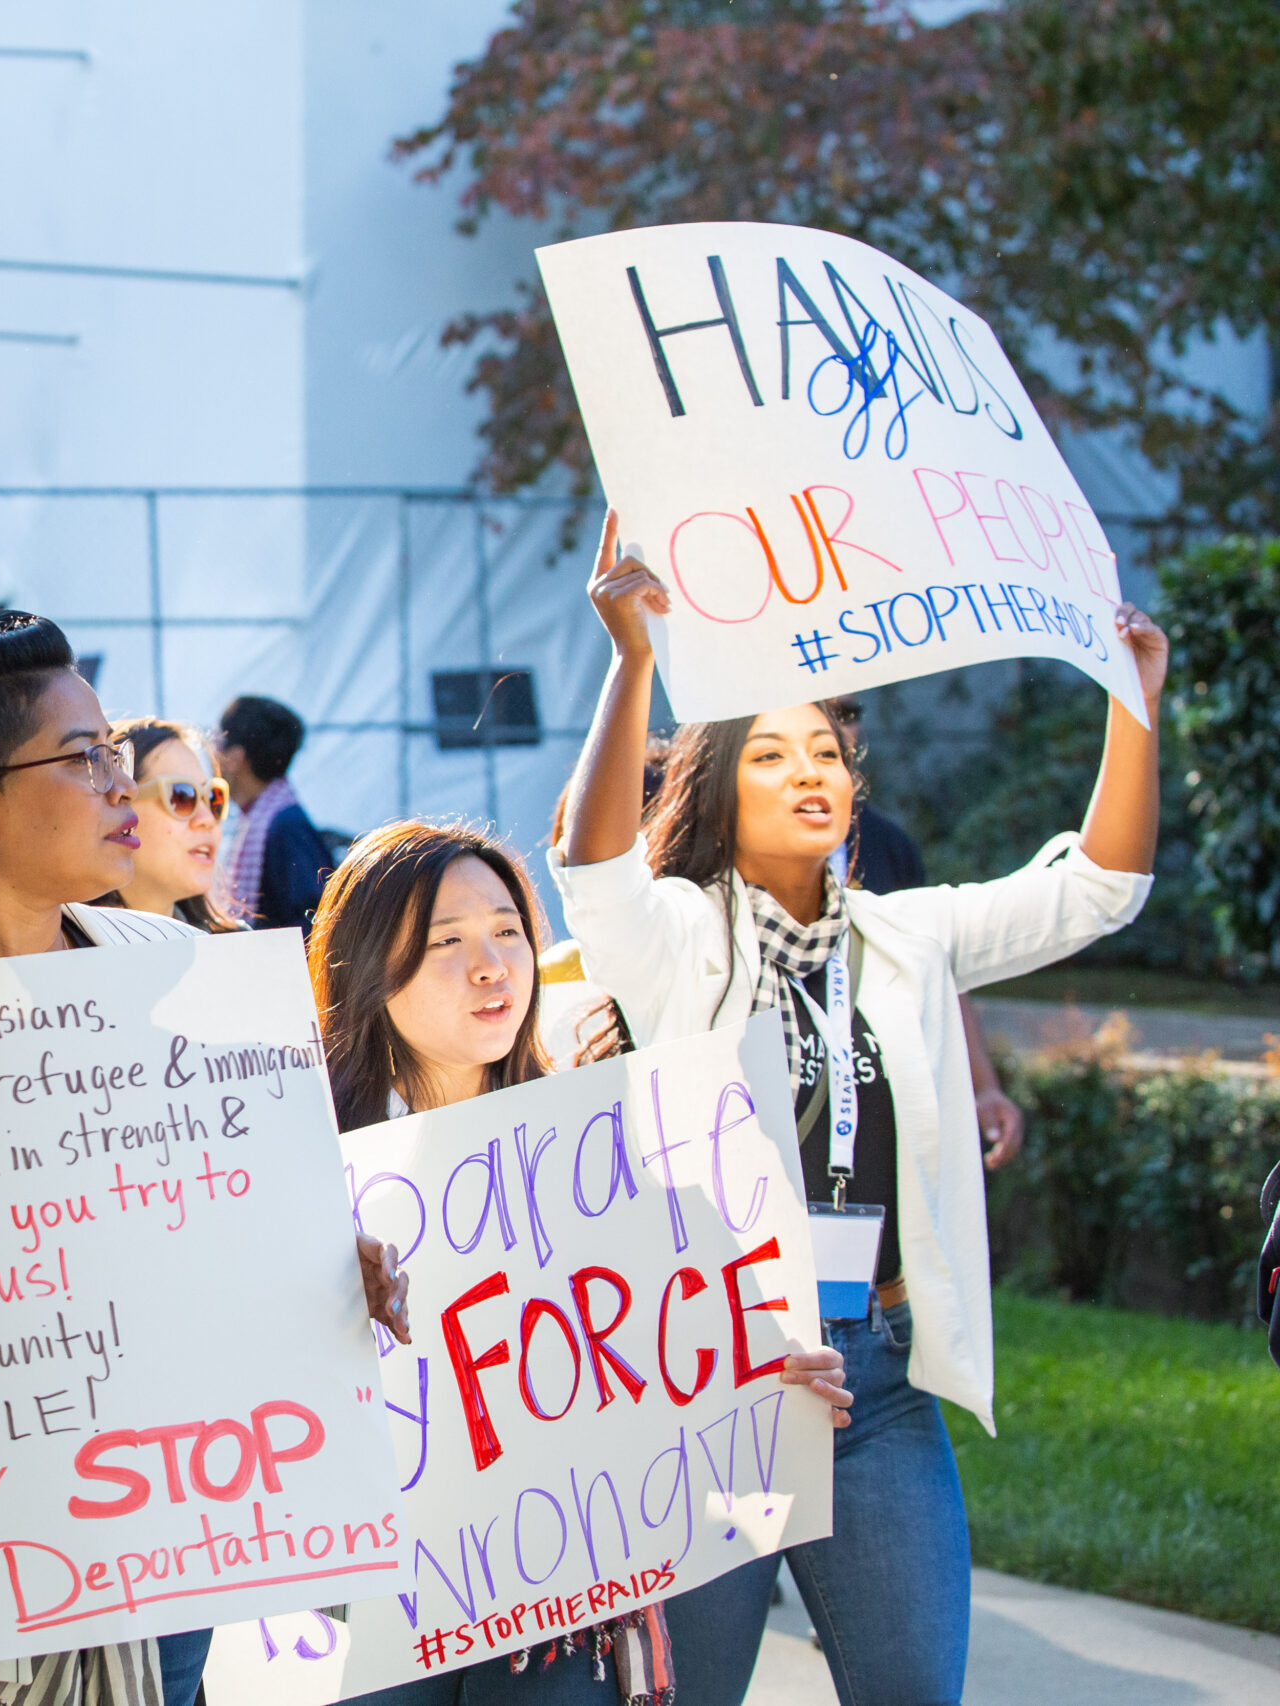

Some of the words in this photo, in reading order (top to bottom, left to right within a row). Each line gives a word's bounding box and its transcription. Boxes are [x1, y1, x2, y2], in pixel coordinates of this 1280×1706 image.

[626, 255, 1023, 441] HANDS
[670, 484, 903, 624] OUR
[913, 467, 1120, 608] PEOPLE
[791, 582, 1109, 675] #STOPTHERAIDS
[163, 1034, 196, 1090] &
[201, 1020, 323, 1100] immigrant
[5, 1130, 44, 1172] in
[59, 1101, 210, 1167] strength
[220, 1096, 251, 1139] &
[10, 1194, 96, 1253] you
[108, 1162, 188, 1232] try
[195, 1151, 252, 1201] to
[440, 1236, 792, 1472] FORCE
[67, 1399, 326, 1520] STOP
[412, 1558, 676, 1670] #STOPTHERAIDS
